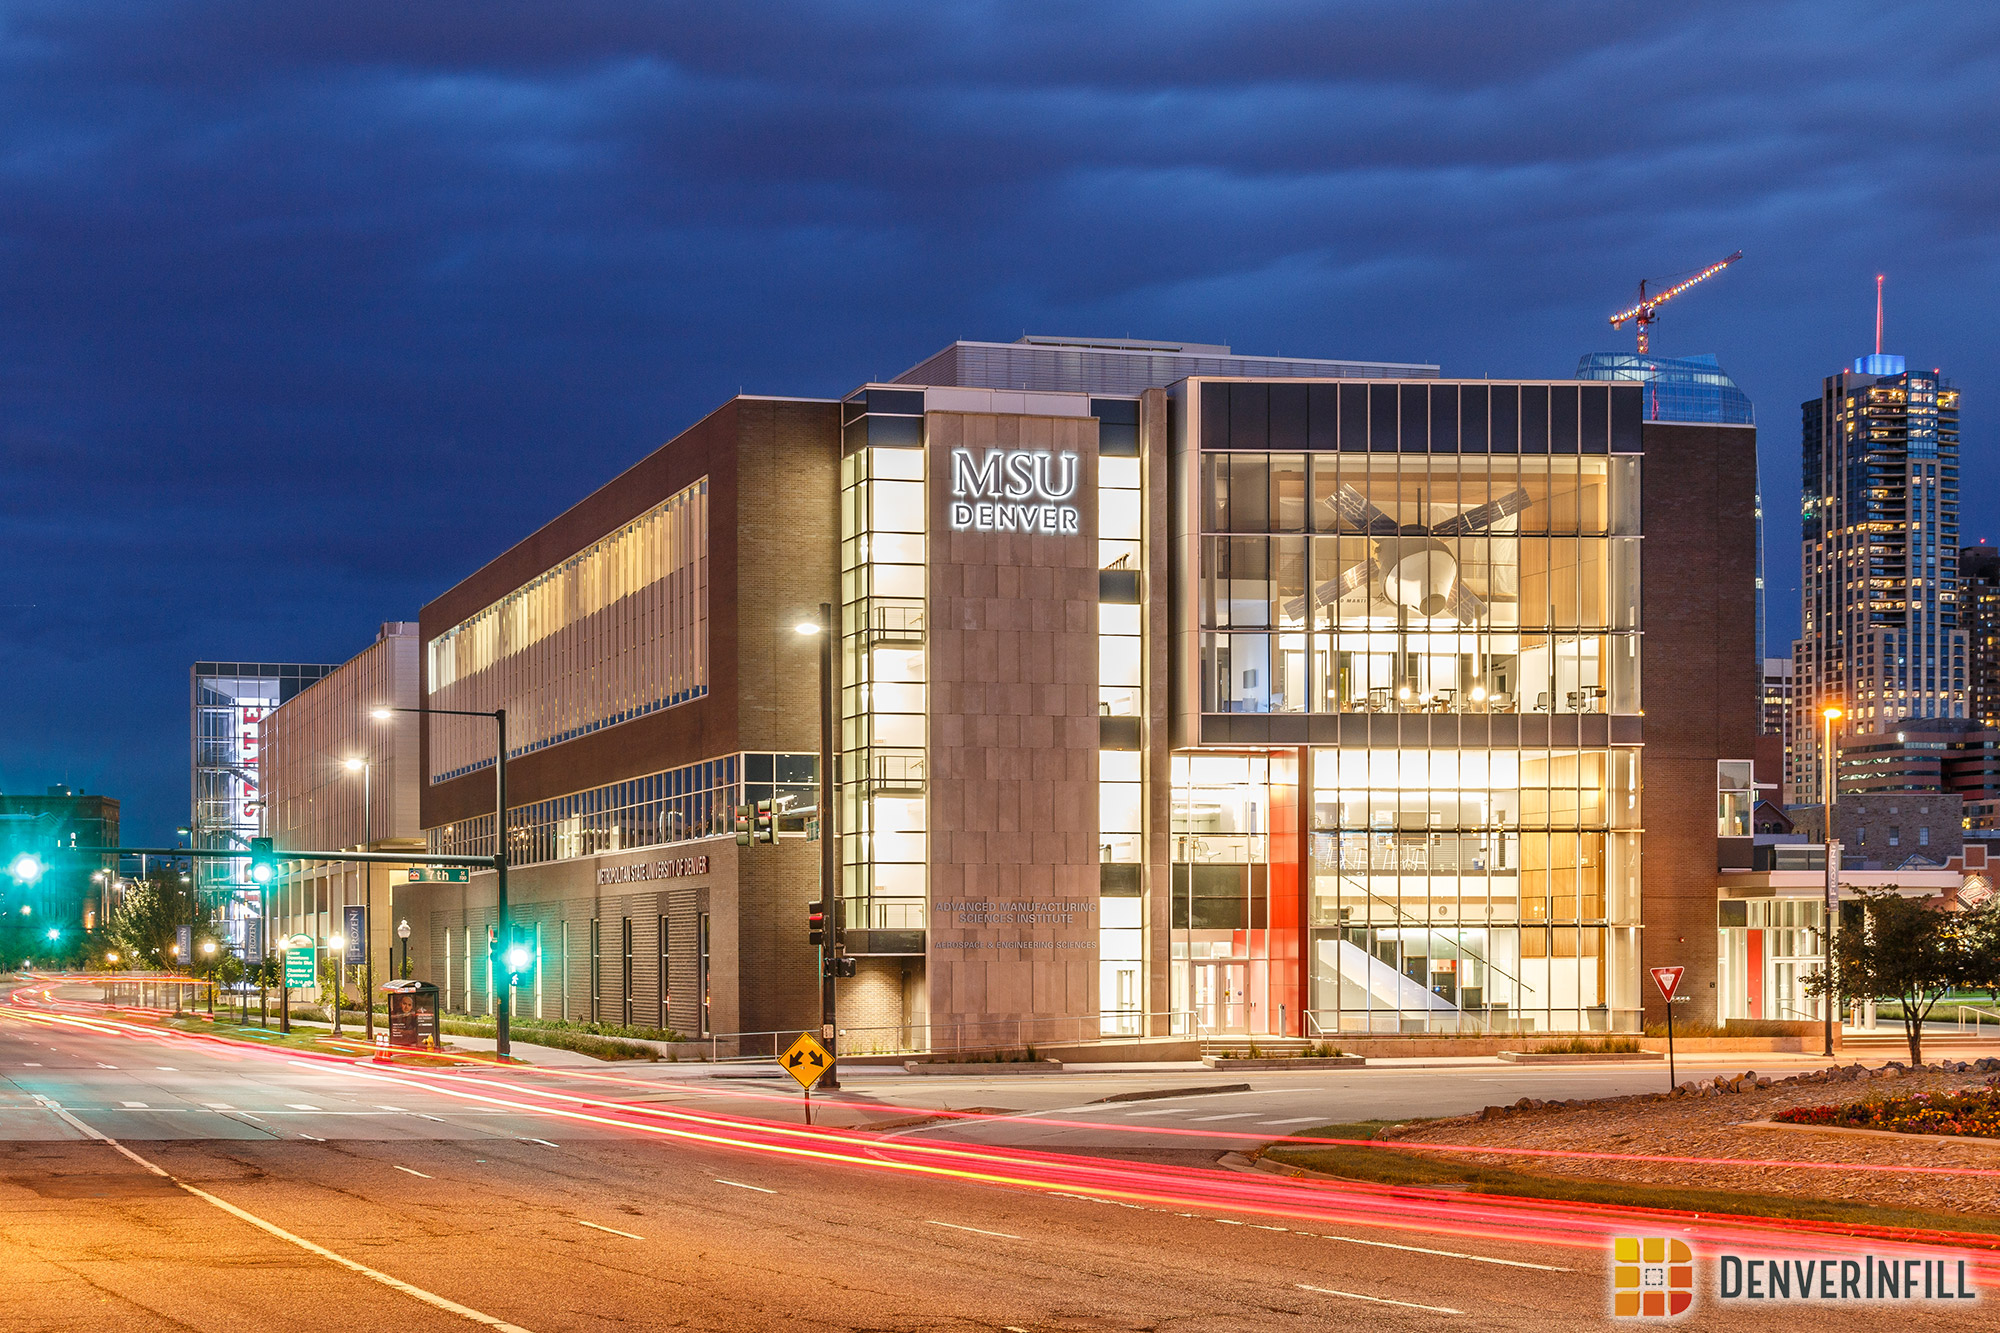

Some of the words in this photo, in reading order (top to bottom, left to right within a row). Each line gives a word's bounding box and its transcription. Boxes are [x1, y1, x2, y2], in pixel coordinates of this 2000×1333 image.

[954, 450, 1078, 498] MSU
[954, 504, 1078, 531] DENVER
[429, 870, 449, 881] 7th
[630, 863, 646, 882] STATE
[646, 859, 676, 880] UNIVERSITY
[676, 858, 684, 877] OF
[684, 855, 708, 876] DENVER
[936, 902, 996, 912] ADVANCED
[999, 902, 1097, 912] MANUFACTURING
[959, 913, 1014, 923] SCIENCES
[1016, 913, 1073, 923] INSTITUTE
[248, 922, 257, 954] FROZEN
[349, 913, 360, 951] FROZEN
[936, 941, 985, 949] AEROSPACE
[987, 941, 994, 949] &
[996, 941, 1054, 949] ENGINEERING
[1056, 941, 1097, 949] SCIENCES
